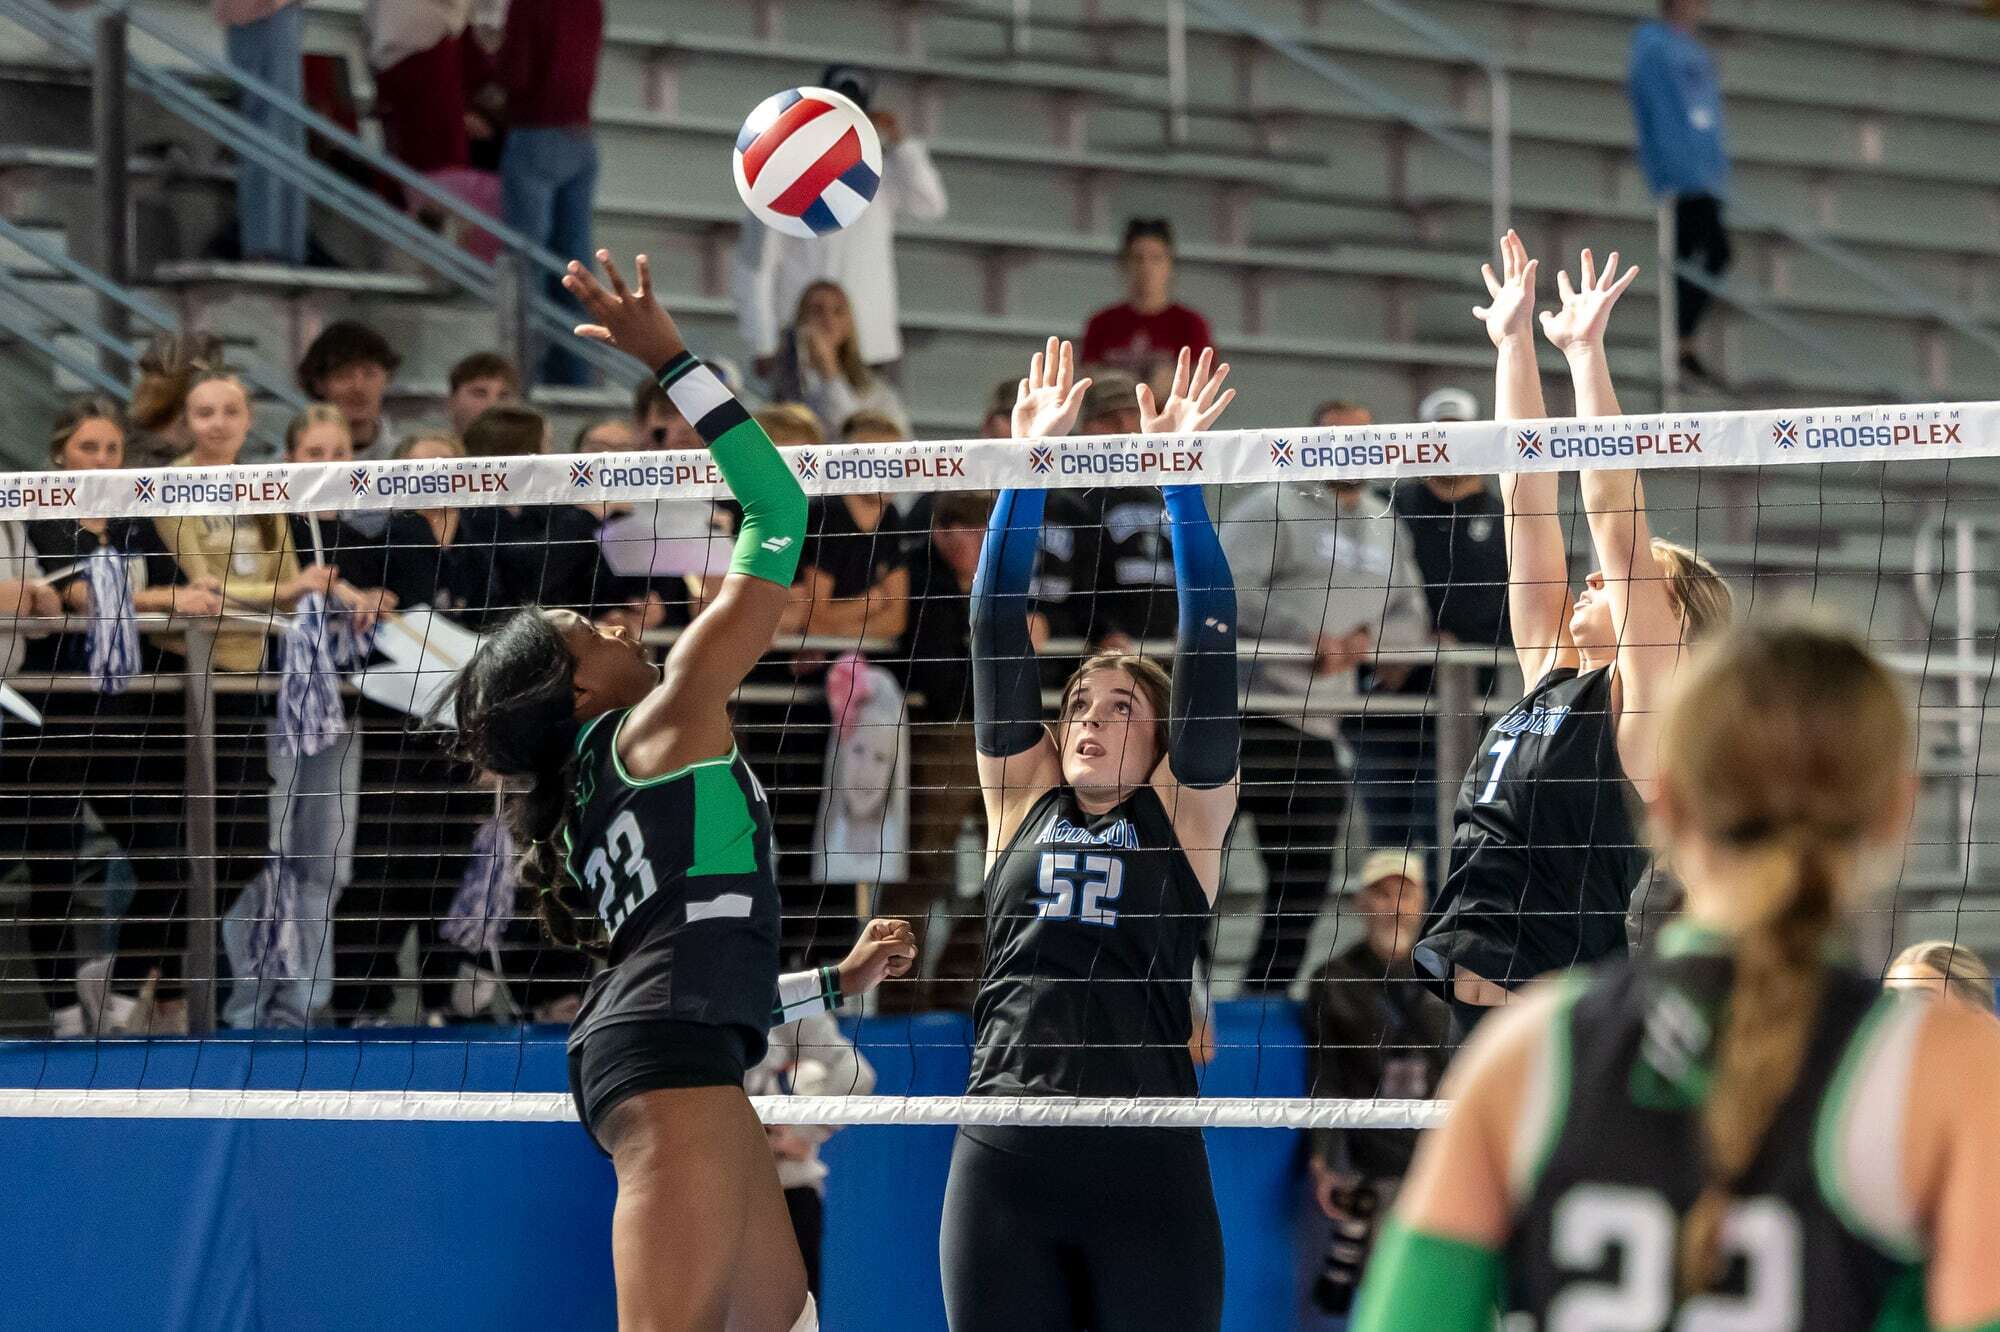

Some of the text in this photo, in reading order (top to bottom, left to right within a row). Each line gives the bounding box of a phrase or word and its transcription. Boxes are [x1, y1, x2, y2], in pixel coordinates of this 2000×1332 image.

[1550, 420, 1700, 434] BIRMINGHAM
[1806, 411, 1960, 424] BIRMINGHAM
[1060, 439, 1203, 451] BIRMINGHAM
[1301, 431, 1447, 443] BIRMINGHAM
[1550, 432, 1703, 458] CROSSPLEX
[1805, 423, 1962, 449] CROSSPLEX
[599, 454, 713, 465] BIRMINGH
[826, 445, 964, 457] BIRMINGHAM
[1301, 443, 1450, 467] CROSSPLEX
[377, 461, 509, 473] BIRMINGHAM
[825, 457, 966, 480] CROSSPLEX
[1060, 451, 1204, 474] CROSSPLEX
[162, 470, 289, 482] BIRMINGHAM
[377, 473, 510, 496] CROSSPLEX
[599, 465, 723, 487] CROSSPLE
[161, 482, 291, 504] CROSSPLEX
[1477, 735, 1520, 804] 7
[584, 810, 658, 943] 23
[1036, 851, 1125, 929] 52
